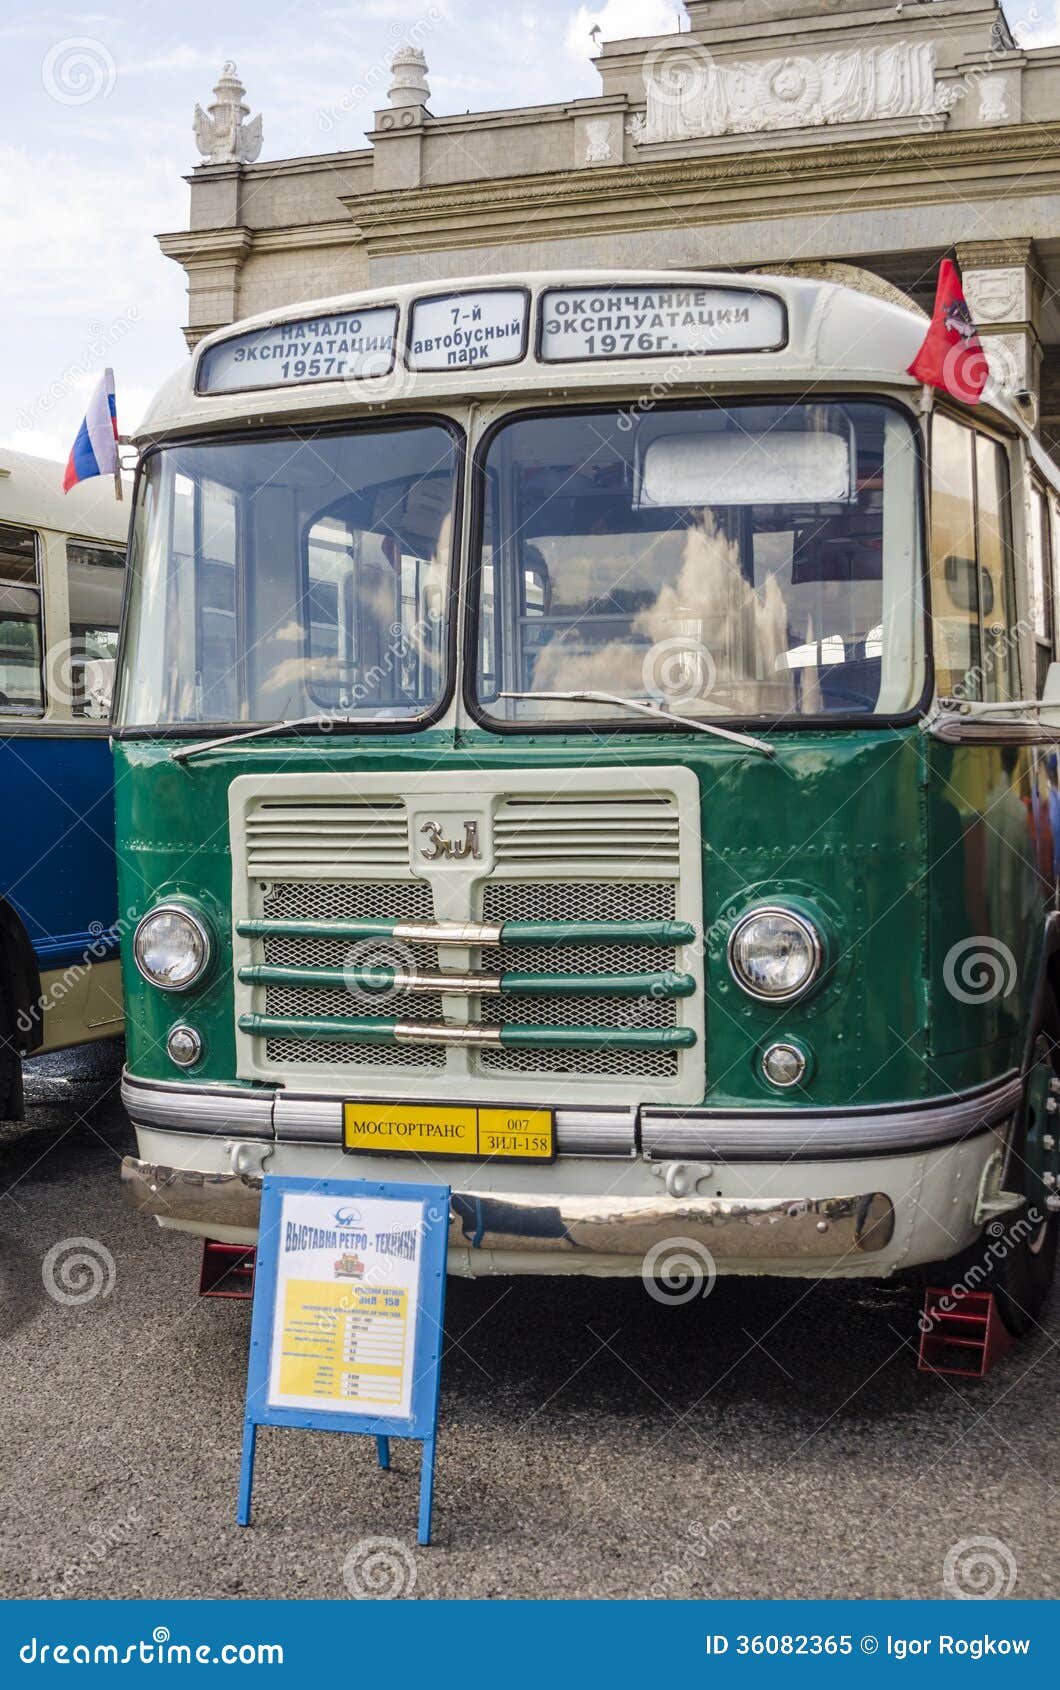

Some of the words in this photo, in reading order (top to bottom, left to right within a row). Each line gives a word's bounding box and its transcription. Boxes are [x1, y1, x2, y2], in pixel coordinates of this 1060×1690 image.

[555, 292, 706, 315] ОКОНЧАНИЕ
[451, 305, 481, 325] 7-й
[546, 308, 750, 334] ЭКСПЛУАТАЦИИ
[281, 320, 362, 340] НАЧАЛО
[414, 319, 520, 354] автобусный
[234, 335, 393, 362] ЭКСПЛУАТАЦИИ
[585, 333, 678, 354] 1976г.
[448, 345, 489, 364] парк
[281, 358, 355, 378] 1957г.
[352, 1120, 466, 1138] МОСГОРТРАНС
[507, 1119, 529, 1131] 007
[487, 1135, 548, 1151] ЗИЛ-158
[285, 1221, 337, 1253] ВЫСТАВКА
[339, 1231, 368, 1250] РЕТРО
